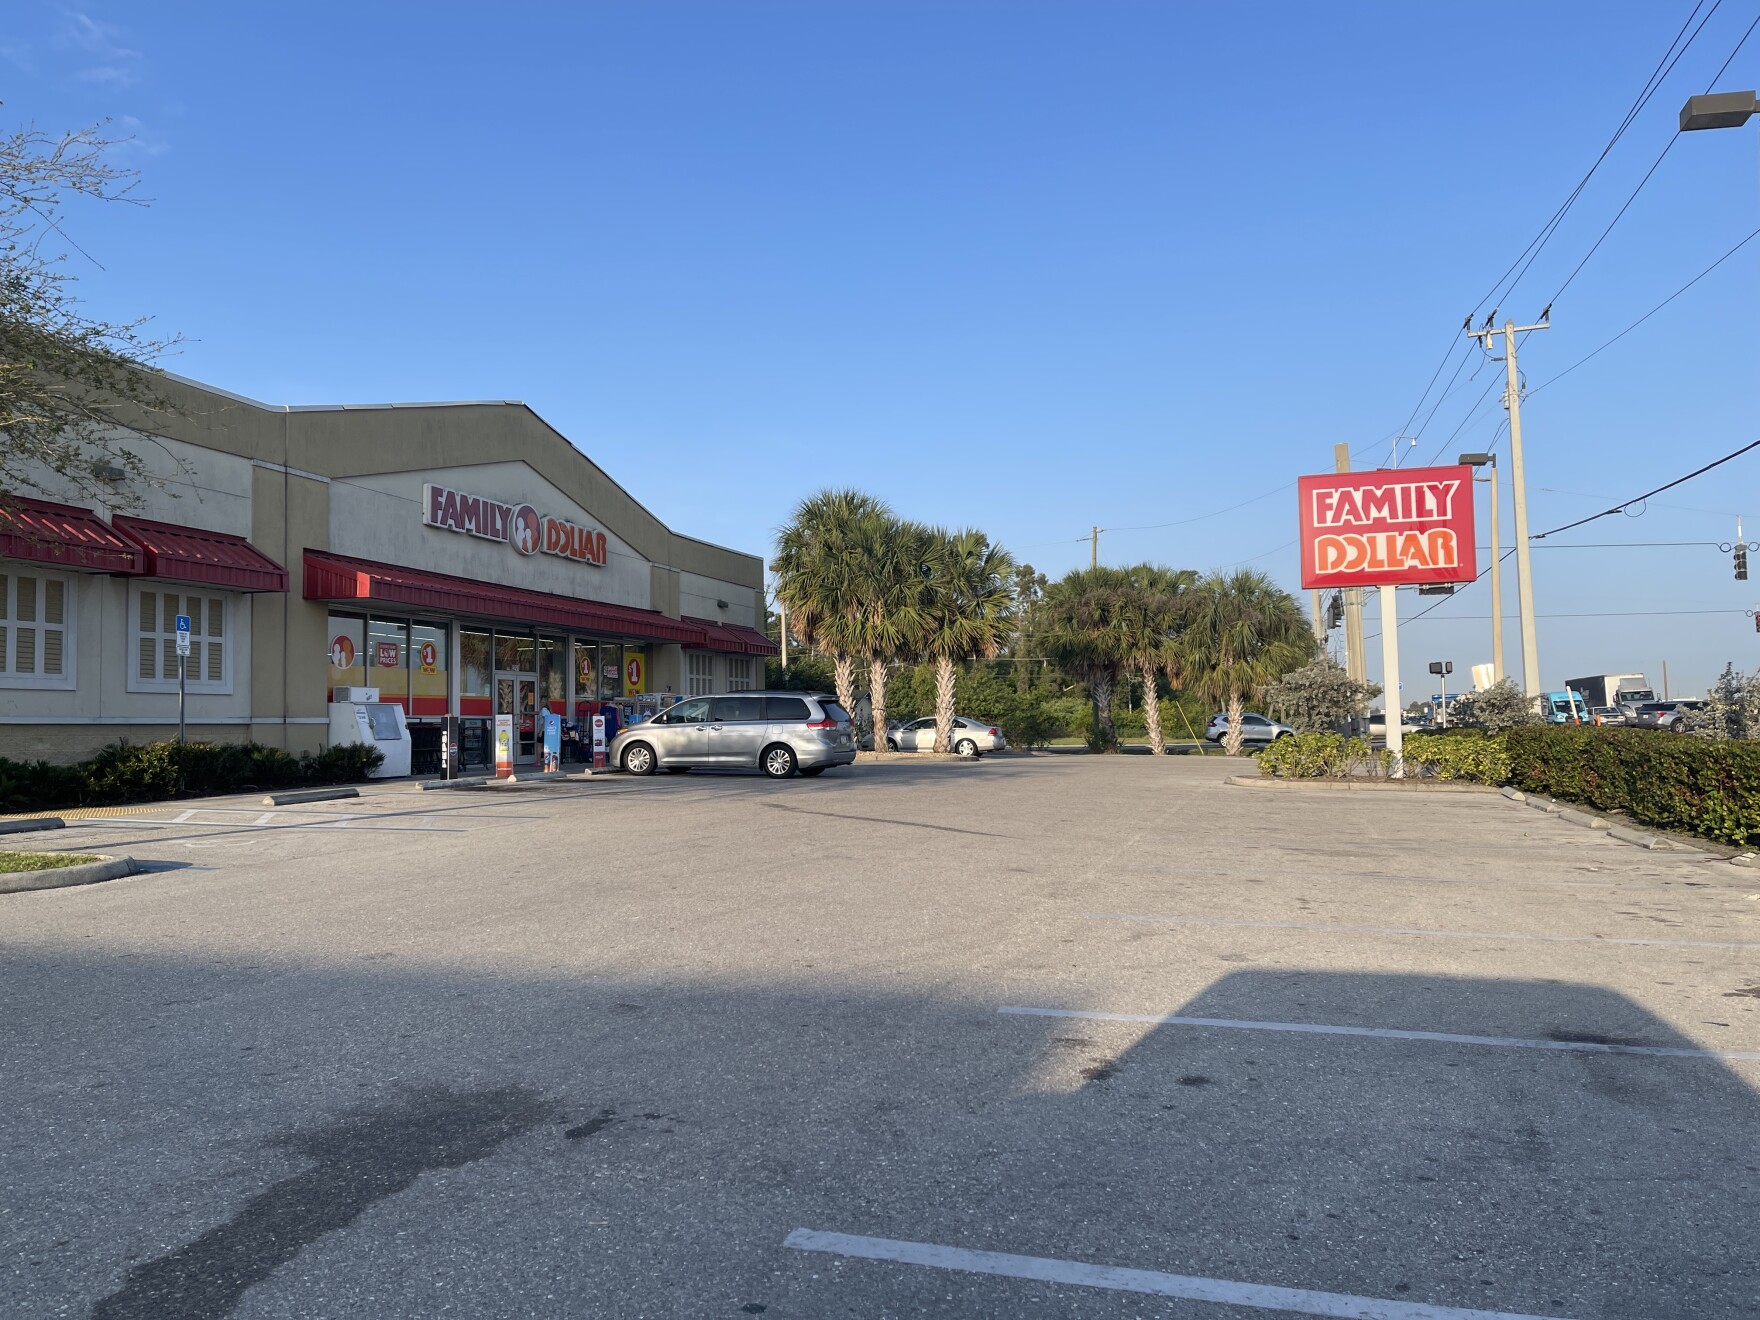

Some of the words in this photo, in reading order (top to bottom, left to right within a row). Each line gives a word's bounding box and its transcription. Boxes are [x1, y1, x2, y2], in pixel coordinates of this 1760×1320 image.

[430, 485, 513, 541] FAMILY
[545, 517, 607, 565] DOLLAR
[1312, 479, 1462, 527] FAMILY
[1314, 527, 1459, 574] DOLLAR
[380, 649, 396, 658] LOW
